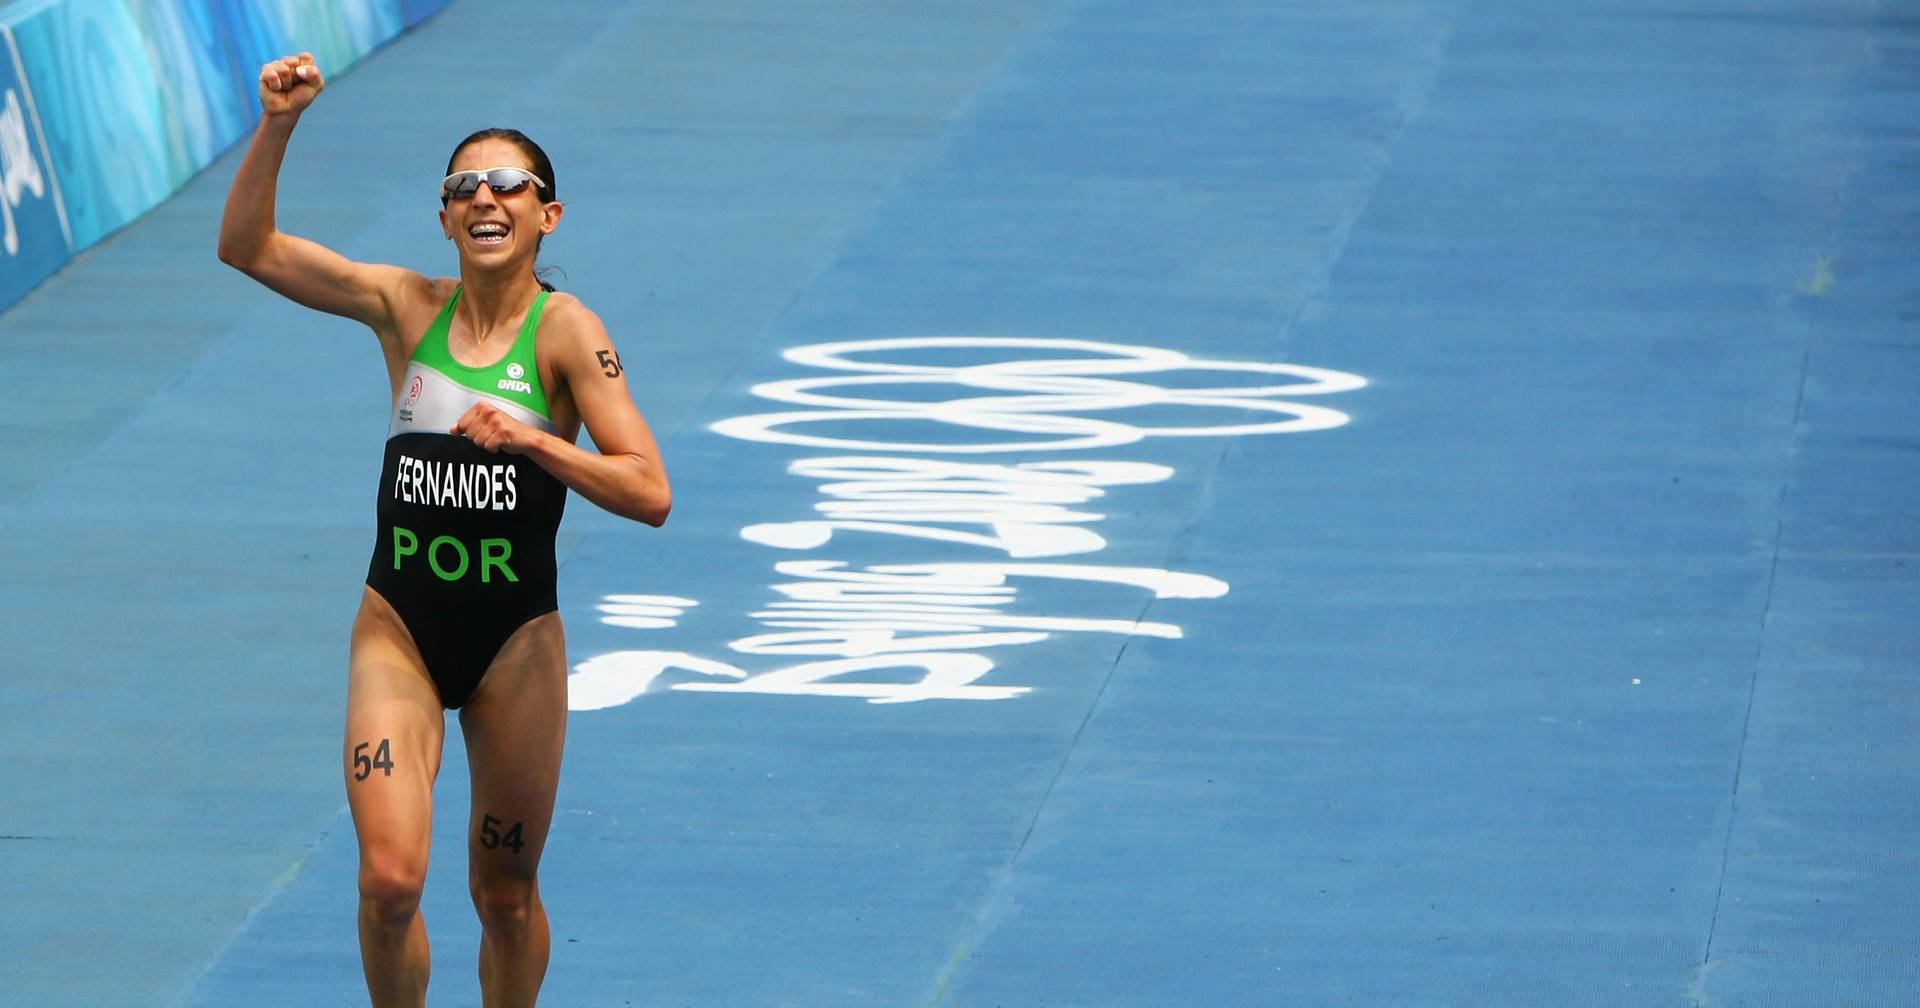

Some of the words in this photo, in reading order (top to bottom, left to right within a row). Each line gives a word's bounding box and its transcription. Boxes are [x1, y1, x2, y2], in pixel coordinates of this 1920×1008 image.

[394, 454, 517, 511] FERNANDES
[740, 456, 1175, 558] 2008
[393, 526, 519, 583] POR
[567, 560, 1230, 712] Beijing
[353, 738, 394, 782] 54
[480, 813, 524, 854] 54
